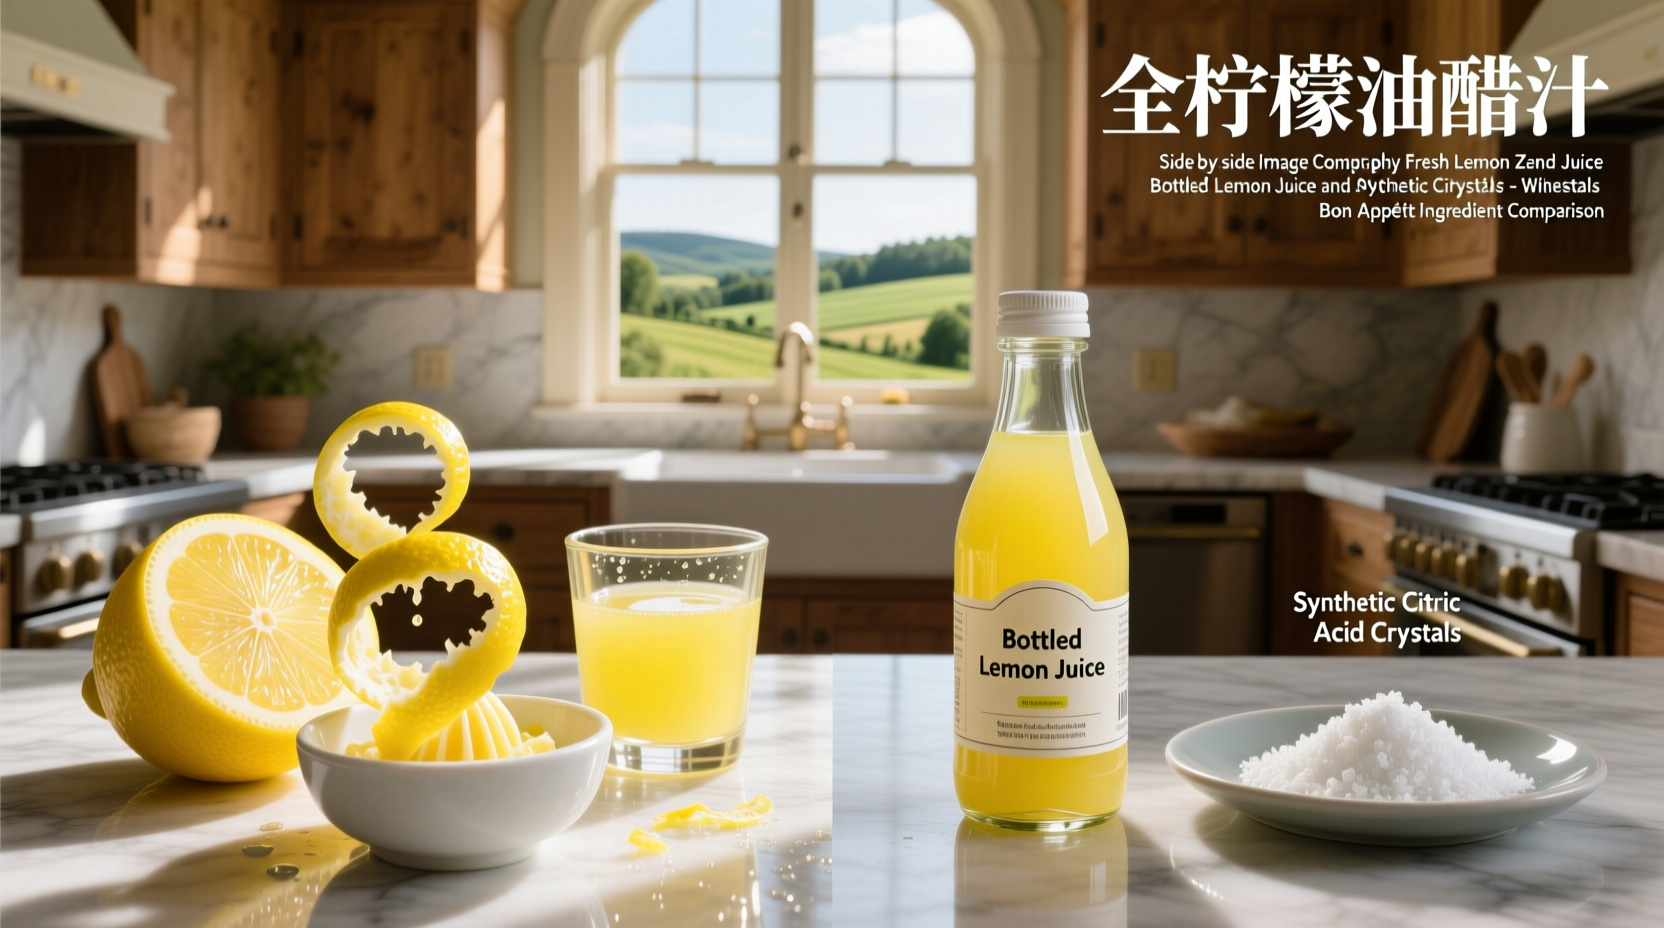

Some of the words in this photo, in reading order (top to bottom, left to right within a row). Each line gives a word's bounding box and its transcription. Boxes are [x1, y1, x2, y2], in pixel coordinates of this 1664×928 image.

[1002, 627, 1082, 650] Bottled
[979, 655, 1049, 680] Lemon
[1054, 657, 1106, 680] Juice
